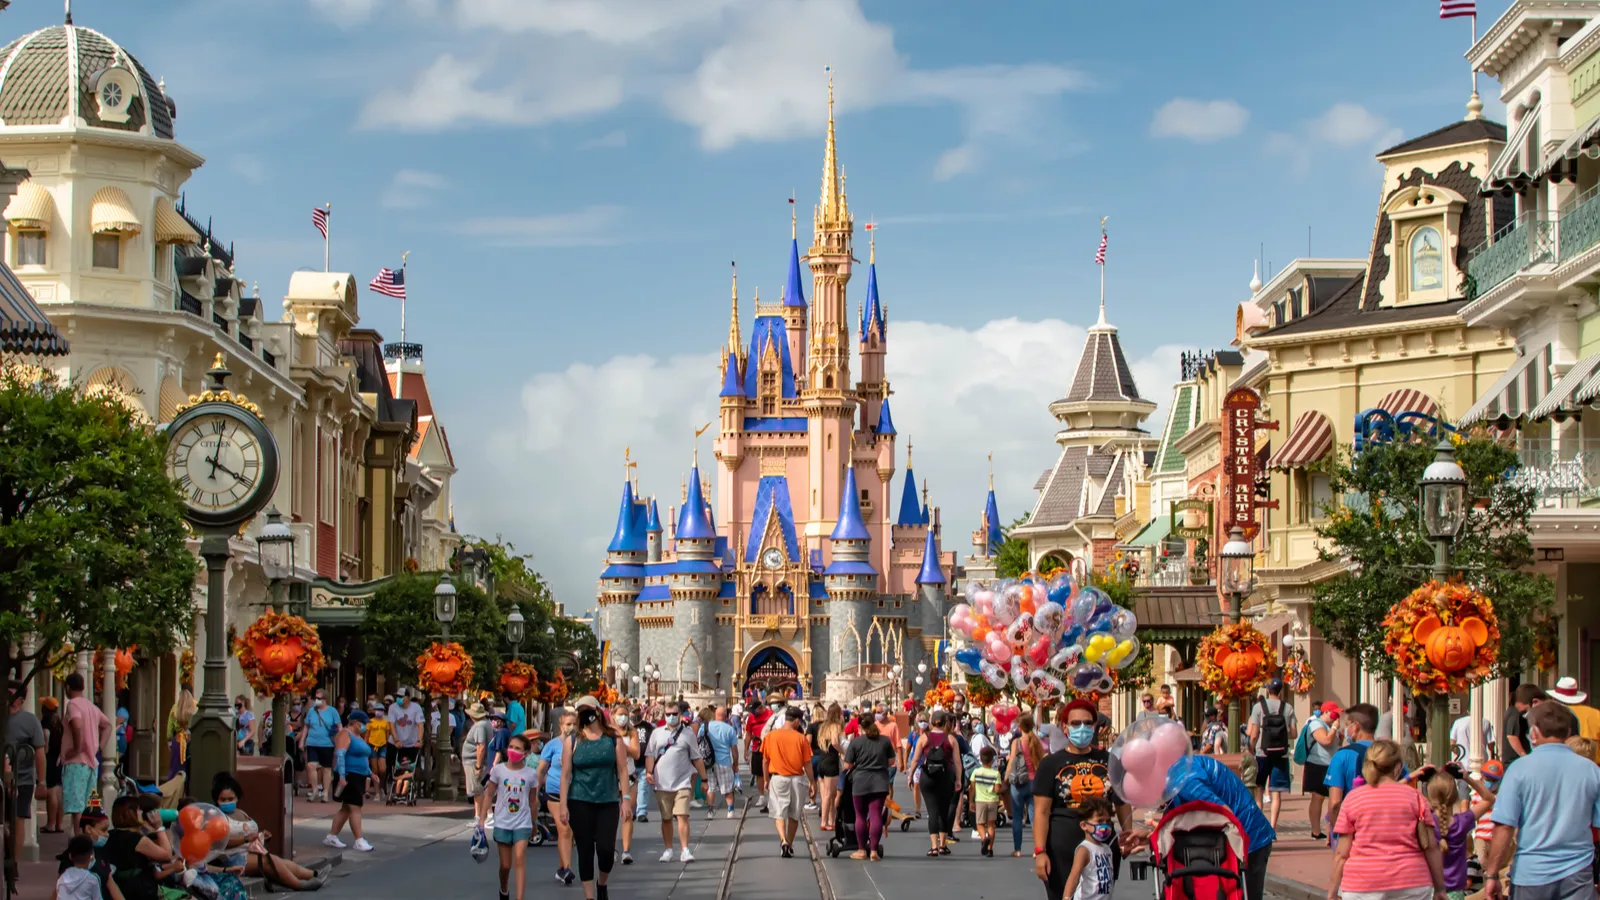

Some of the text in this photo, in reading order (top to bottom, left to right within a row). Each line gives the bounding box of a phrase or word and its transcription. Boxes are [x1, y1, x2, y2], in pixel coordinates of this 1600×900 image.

[1235, 408, 1249, 521] CRYSTAL ARTS
[1179, 528, 1205, 538] COFFEE
